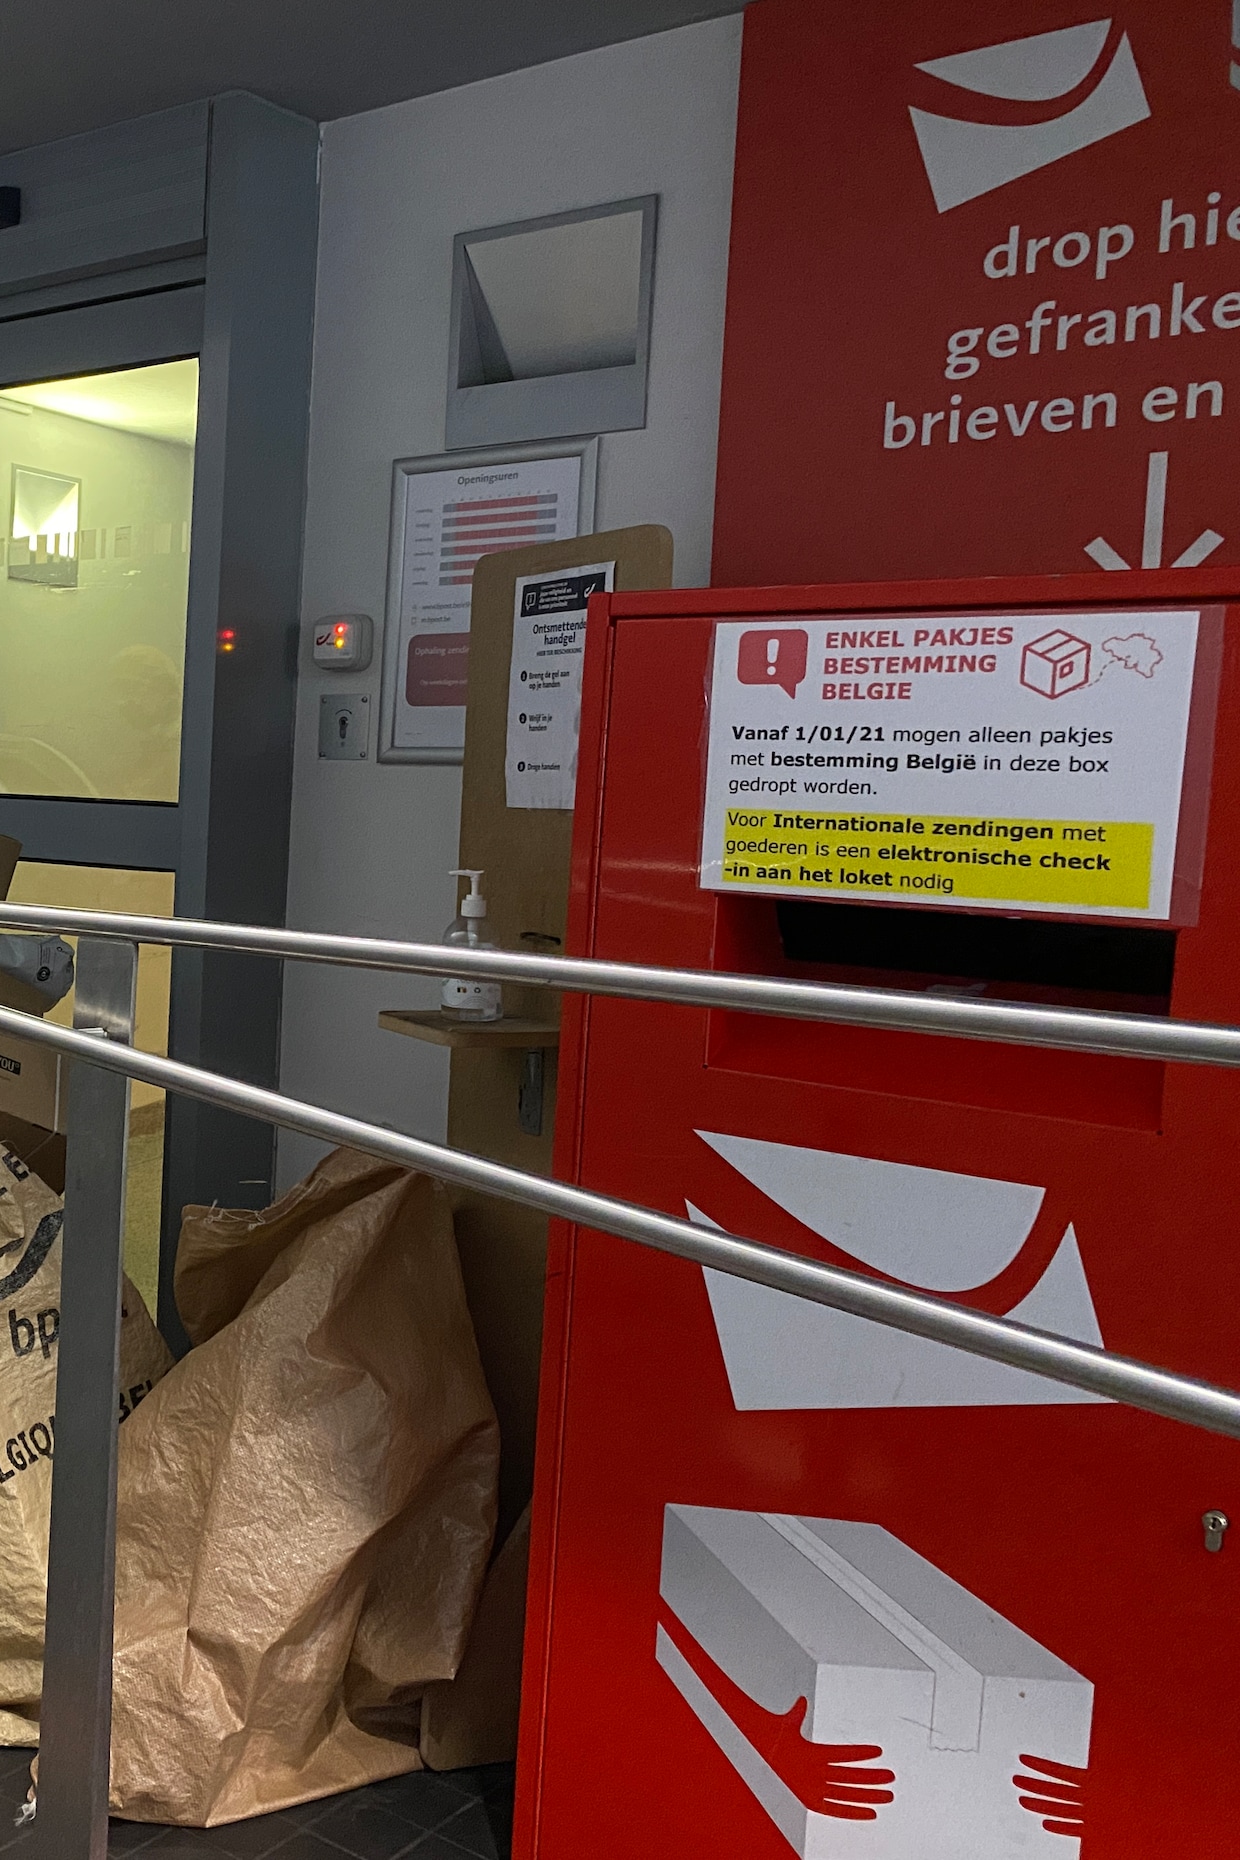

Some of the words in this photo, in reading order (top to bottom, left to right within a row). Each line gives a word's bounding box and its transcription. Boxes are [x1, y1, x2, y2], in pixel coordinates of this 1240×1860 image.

[983, 224, 1135, 280] drop
[944, 282, 1240, 380] gefranke
[883, 393, 1117, 450] brieven
[1141, 379, 1223, 422] en
[456, 472, 519, 485] Openingsuren
[544, 632, 576, 646] handgel
[825, 630, 905, 649] ENKEL
[913, 627, 1014, 647] PAKJES
[823, 655, 997, 675] BESTEMMING
[821, 682, 912, 701] BELGIE
[732, 726, 790, 741] Vanaf
[795, 726, 885, 744] 1/01/21
[892, 729, 961, 745] mogen
[968, 726, 1032, 744] alleen
[1040, 727, 1114, 748] pakjes
[730, 752, 765, 766] met
[770, 751, 899, 772] bestemming
[906, 754, 977, 774] België
[983, 755, 1002, 771] in
[1009, 755, 1061, 772] deze
[1069, 755, 1110, 772] box
[728, 777, 797, 796] gedropt
[804, 778, 878, 795] worden.
[727, 811, 768, 827] Voor
[772, 813, 925, 834] Internationale
[932, 821, 1054, 842] zendingen
[1062, 826, 1107, 842] met
[726, 838, 808, 855] goederen
[815, 842, 830, 856] is
[836, 846, 871, 858] een
[877, 844, 1032, 867] elektronische
[1039, 852, 1111, 871] check
[724, 862, 750, 878] -in
[756, 865, 792, 880] aan
[799, 866, 833, 883] het
[839, 868, 893, 887] loket
[899, 873, 955, 894] nodig
